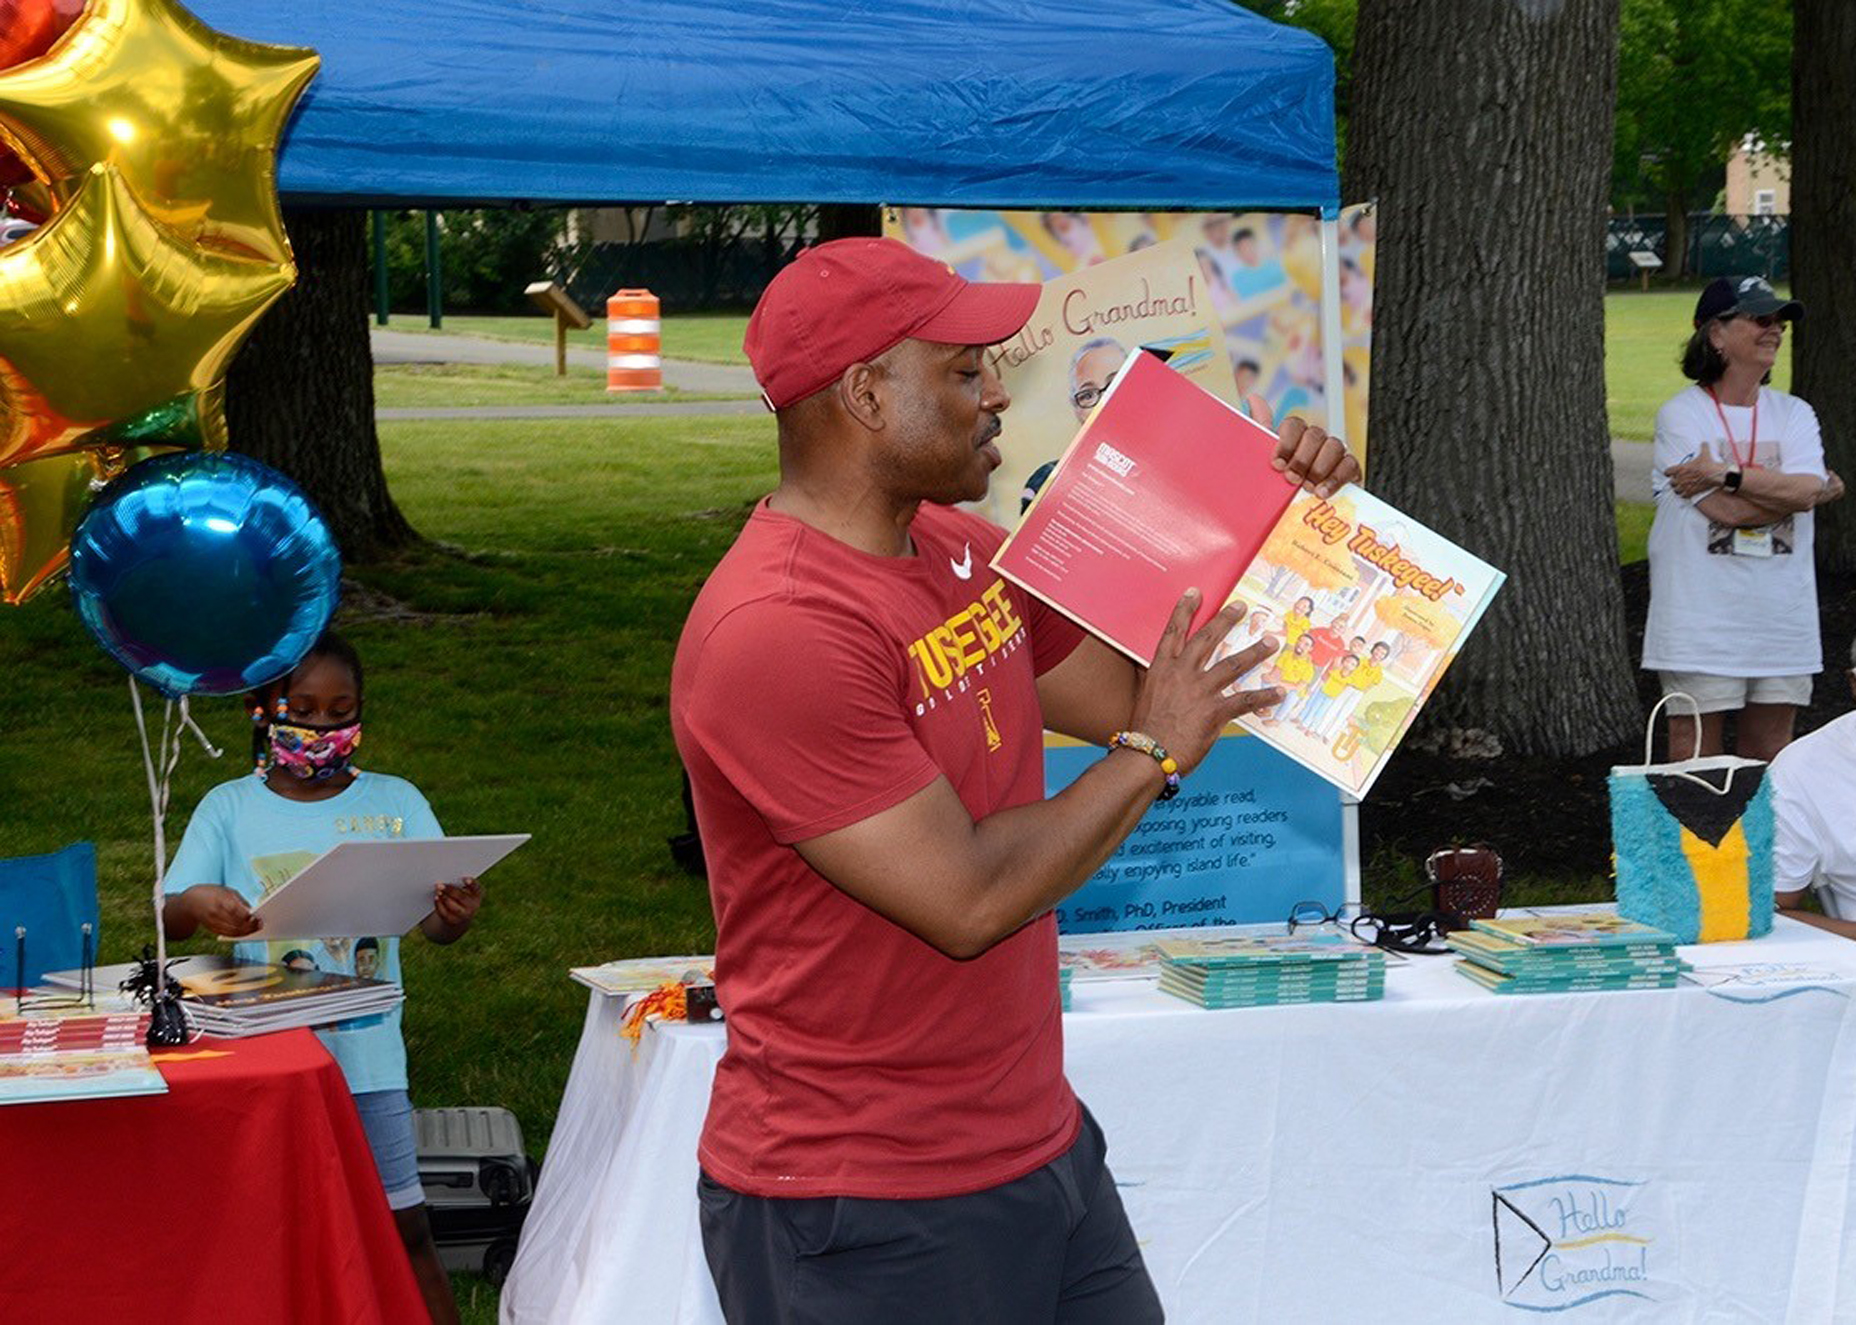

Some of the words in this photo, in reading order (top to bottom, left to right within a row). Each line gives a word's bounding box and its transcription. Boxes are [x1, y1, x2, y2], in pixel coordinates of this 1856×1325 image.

[986, 322, 1054, 381] Hello
[1062, 275, 1197, 336] Grandma!
[1303, 500, 1351, 546] Hey
[1135, 819, 1185, 836] xposing
[1192, 815, 1233, 834] young
[1237, 809, 1288, 825] readers
[1131, 837, 1205, 857] excitement
[1210, 833, 1226, 849] of
[1124, 861, 1181, 882] enjoying
[1187, 855, 1222, 873] island
[1074, 906, 1119, 923] Smith,
[1124, 902, 1157, 919] PhD,
[1161, 894, 1227, 915] President
[1548, 1191, 1628, 1238] Hello
[1541, 1246, 1648, 1293] Grandma!
